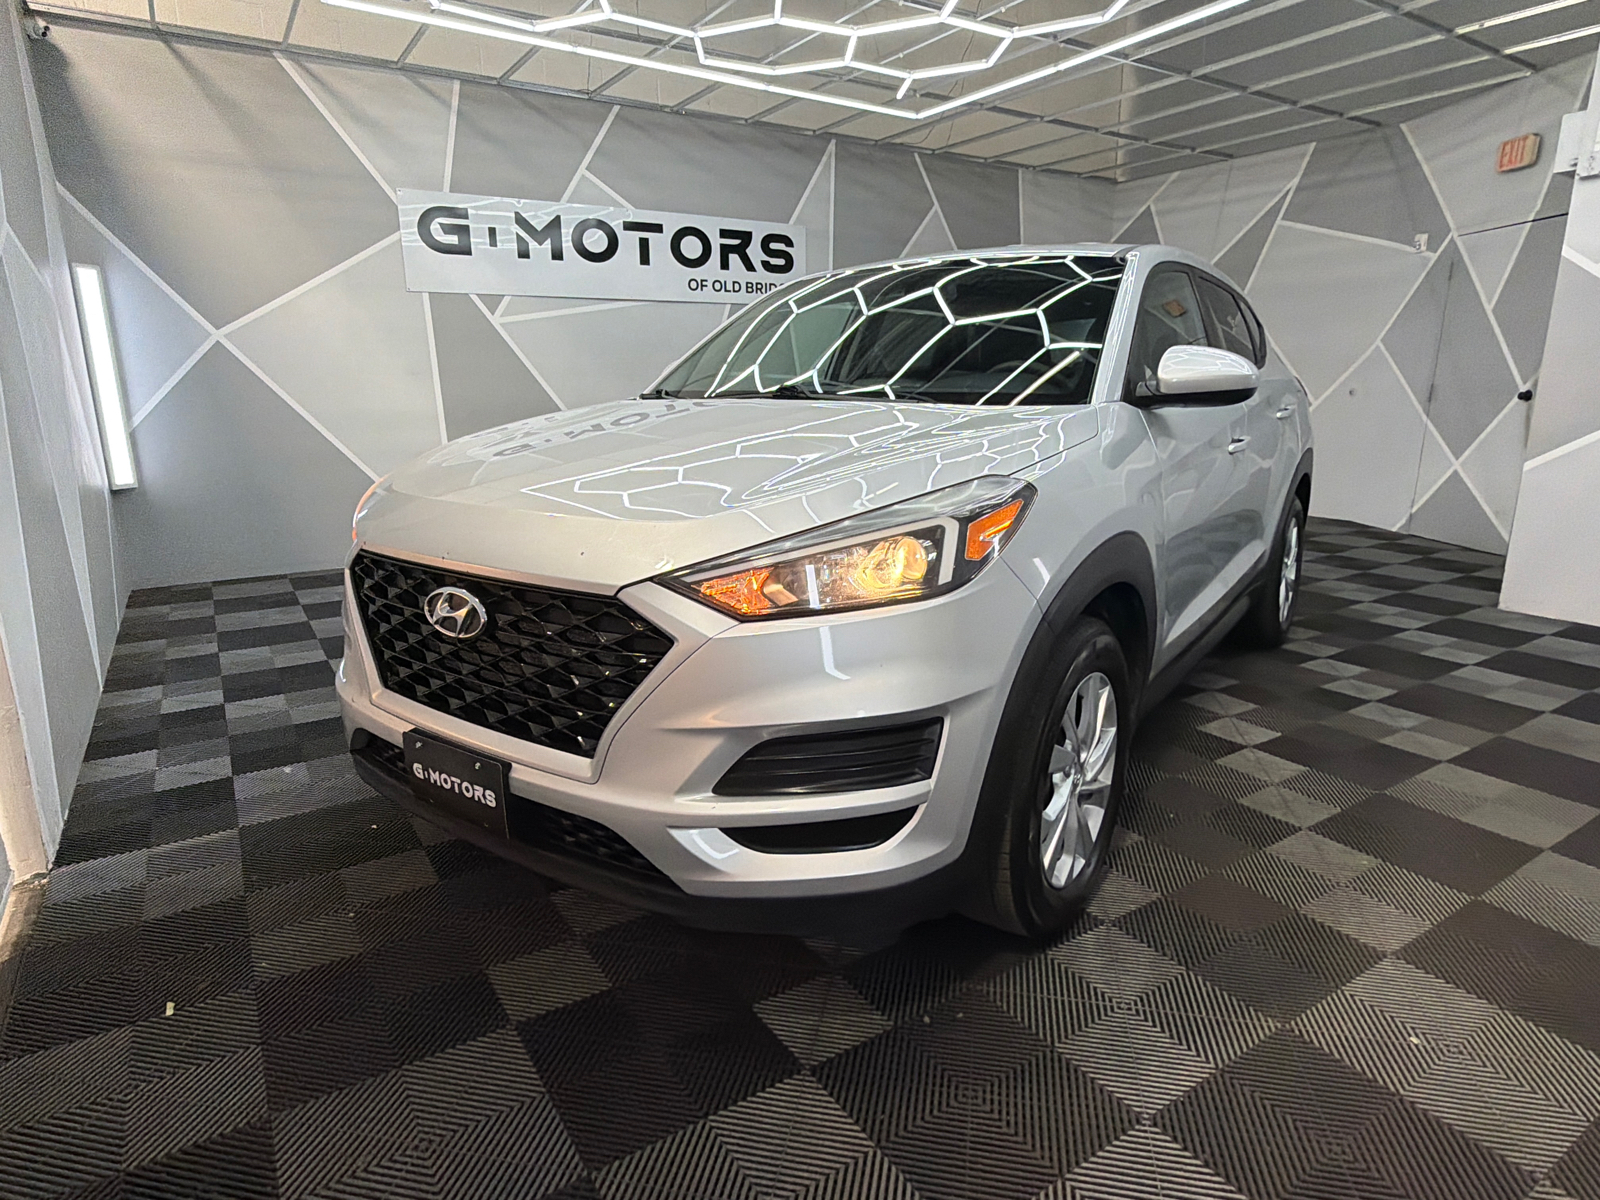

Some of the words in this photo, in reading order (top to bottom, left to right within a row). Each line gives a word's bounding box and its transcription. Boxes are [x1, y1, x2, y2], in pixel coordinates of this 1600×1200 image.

[688, 278, 708, 291] OF
[712, 280, 742, 293] OLD
[745, 282, 784, 295] BRID
